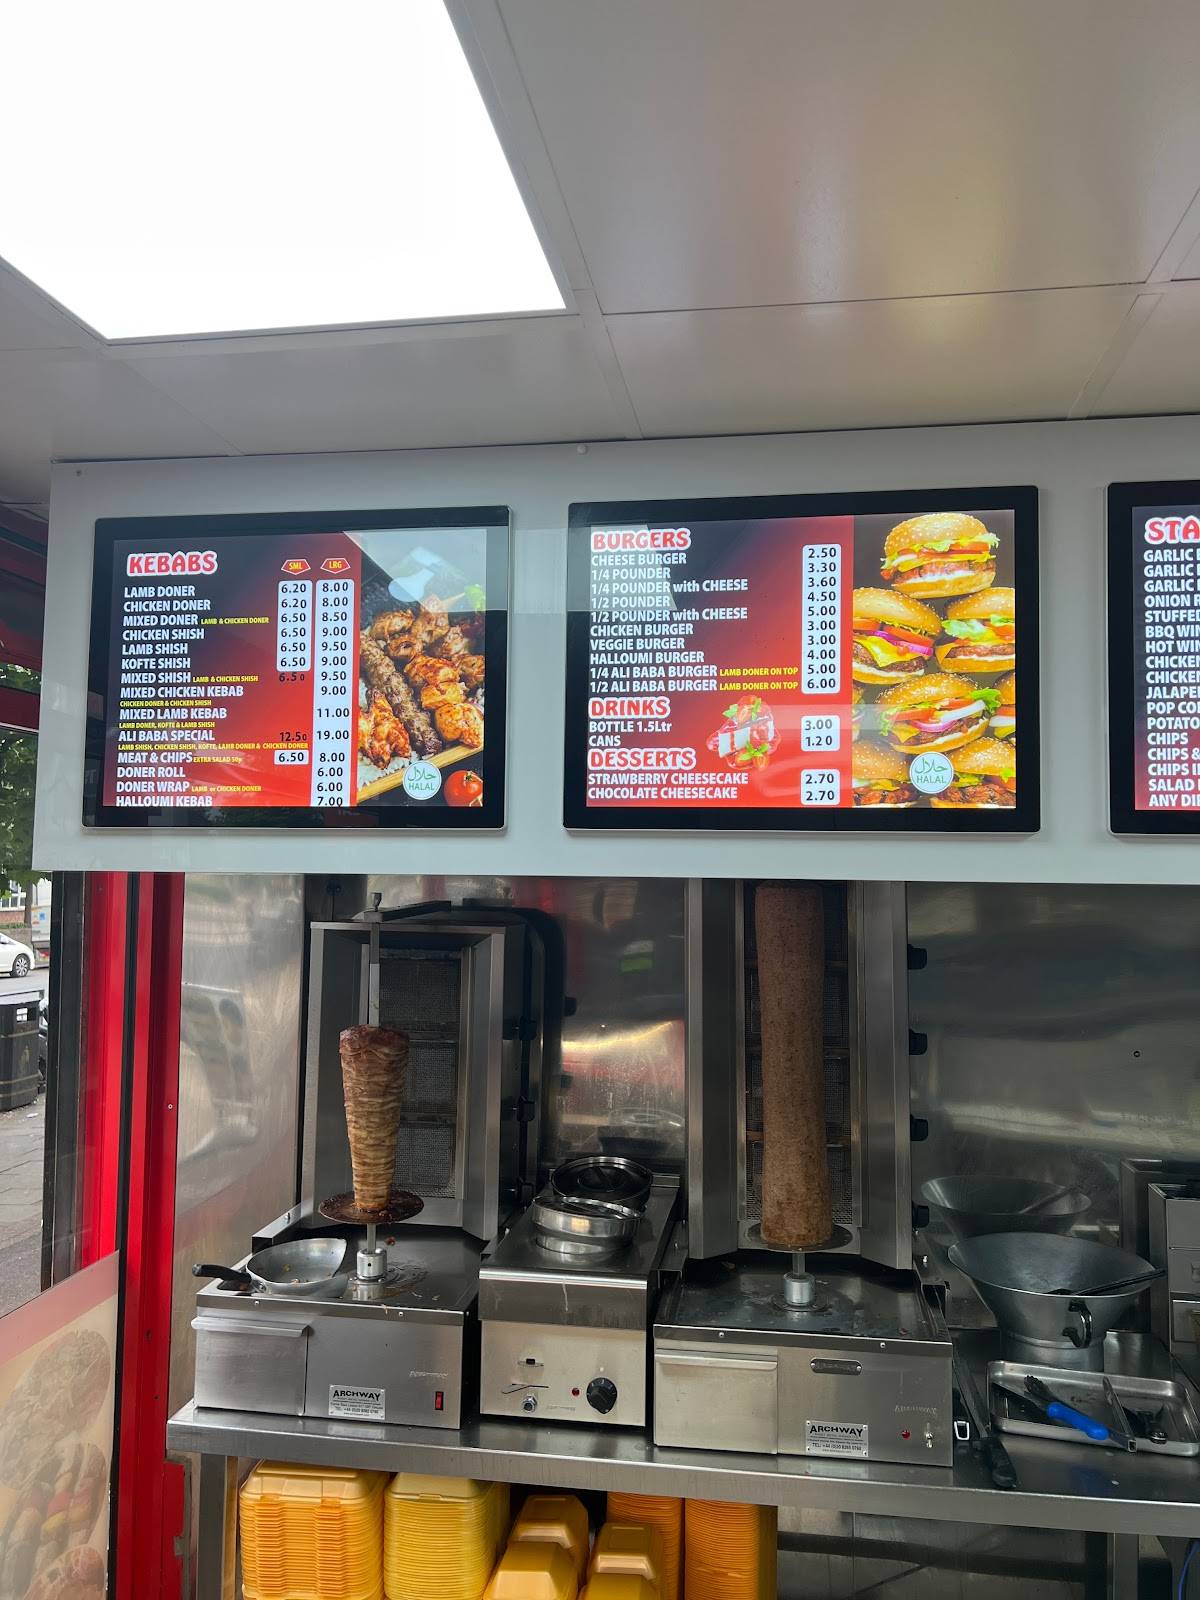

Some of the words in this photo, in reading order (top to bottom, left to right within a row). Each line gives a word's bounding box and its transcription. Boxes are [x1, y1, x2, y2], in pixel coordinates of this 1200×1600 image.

[591, 528, 691, 552] BURGERS
[808, 548, 836, 558] 2.50
[1144, 549, 1193, 562] GARLIC
[127, 551, 218, 576] KEBABS
[329, 561, 342, 569] LRG
[591, 555, 635, 566] CHEESE
[638, 553, 686, 565] BURGER
[808, 562, 836, 572] 3.30
[1144, 564, 1194, 577] GARLIC
[592, 570, 609, 580] 1/4
[613, 568, 671, 579] POUNDER
[322, 582, 348, 592] 8.00
[591, 584, 609, 595] 1/4
[613, 582, 670, 594] POUNDER
[673, 581, 699, 593] with
[703, 579, 748, 591] CHEESE
[808, 577, 836, 587] 3.60
[1144, 579, 1194, 592] GARLIC
[124, 587, 155, 598] LAMB
[158, 586, 195, 597] DONER
[281, 584, 306, 593] 6.20
[322, 597, 348, 606] 8.00
[808, 591, 836, 601] 4.50
[1144, 595, 1190, 608] ONION
[124, 601, 170, 612] CHICKEN
[173, 600, 210, 611] DONER
[281, 599, 306, 608] 6.20
[591, 598, 609, 609] 1/2
[612, 596, 670, 608] POUNDER
[322, 612, 347, 621] 8.50
[591, 612, 609, 623] 1/2
[612, 610, 670, 622] POUNDER
[673, 609, 699, 621] with
[702, 608, 747, 620] CHEESE
[808, 606, 836, 616] 5.00
[123, 616, 158, 626] MIXED
[160, 614, 198, 625] DONER
[281, 613, 306, 622] 6.50
[591, 625, 642, 636] CHICKEN
[645, 623, 693, 635] BURGER
[808, 620, 835, 630] 3.00
[123, 630, 169, 640] CHICKEN
[172, 629, 204, 639] SHISH
[281, 628, 306, 637] 6.50
[323, 627, 347, 636] 9.00
[1146, 625, 1174, 639] BBQ
[590, 639, 633, 650] VEGGIE
[636, 638, 685, 649] BURGER
[808, 635, 835, 645] 3.00
[122, 644, 153, 655] LAMB
[156, 643, 188, 654] SHISH
[281, 643, 306, 652] 6.50
[322, 642, 347, 651] 9.50
[1146, 641, 1174, 653] HOT
[590, 653, 652, 664] HALLOUMI
[656, 652, 704, 663] BURGER
[808, 650, 835, 659] 4.00
[122, 659, 156, 669] KOFTE
[158, 658, 190, 668] SHISH
[280, 657, 305, 666] 6.50
[322, 657, 346, 666] 9.00
[591, 667, 608, 679] 1/4
[611, 667, 629, 678] ALI
[633, 666, 665, 678] BABA
[668, 665, 717, 677] BURGER
[743, 668, 769, 676] DONER
[808, 664, 835, 674] 5.00
[121, 673, 156, 684] MIXED
[158, 672, 191, 683] SHISH
[321, 671, 346, 680] 9.50
[591, 681, 608, 693] 1/2
[611, 681, 629, 692] ALI
[633, 680, 665, 691] BABA
[668, 680, 717, 691] BURGER
[808, 679, 835, 688] 6.00
[121, 688, 155, 698] MIXED
[158, 687, 204, 698] CHICKEN
[207, 686, 244, 696] KEBAB
[321, 686, 346, 695] 9.00
[317, 708, 349, 717] 11.00
[589, 696, 670, 718] DRINKS
[1147, 702, 1175, 714] POP
[120, 709, 155, 719] MIXED
[157, 709, 188, 719] LAMB
[191, 708, 227, 718] KEBAB
[589, 721, 634, 732] BOTTLE
[637, 721, 672, 732] 1.5Ltr
[805, 719, 832, 730] 3.00
[119, 731, 136, 741] ALI
[139, 731, 168, 741] BABA
[171, 730, 215, 741] SPECIAL
[317, 731, 349, 740] 19.00
[589, 735, 621, 746] CANS
[806, 736, 832, 746] 1.20
[1147, 732, 1188, 745] CHIPS
[118, 753, 148, 763] MEAT
[150, 752, 158, 763] &
[161, 752, 192, 763] CHIPS
[279, 752, 304, 762] 6.50
[320, 753, 345, 762] 8.00
[588, 747, 696, 770] DESSERTS
[1148, 748, 1189, 761] CHIPS
[117, 767, 155, 778] DONER
[158, 767, 185, 777] ROLL
[318, 768, 343, 777] 6.00
[1148, 763, 1189, 776] CHIPS
[588, 773, 667, 785] STRAWBERRY
[671, 773, 748, 784] CHEESECAKE
[806, 774, 834, 784] 2.70
[117, 782, 154, 792] DONER
[157, 782, 189, 792] WRAP
[317, 783, 342, 792] 6.00
[1149, 779, 1194, 791] SALAD
[588, 788, 657, 799] CHOCOLATE
[661, 787, 737, 799] CHEESECAKE
[806, 790, 834, 800] 2.70
[116, 796, 173, 807] HALLOUMI
[176, 796, 212, 807] KEBAB
[318, 797, 343, 806] 7.00
[1149, 794, 1179, 807] ANY
[333, 1390, 380, 1401] ARCHWAY
[810, 1426, 863, 1437] ARCHWAY
